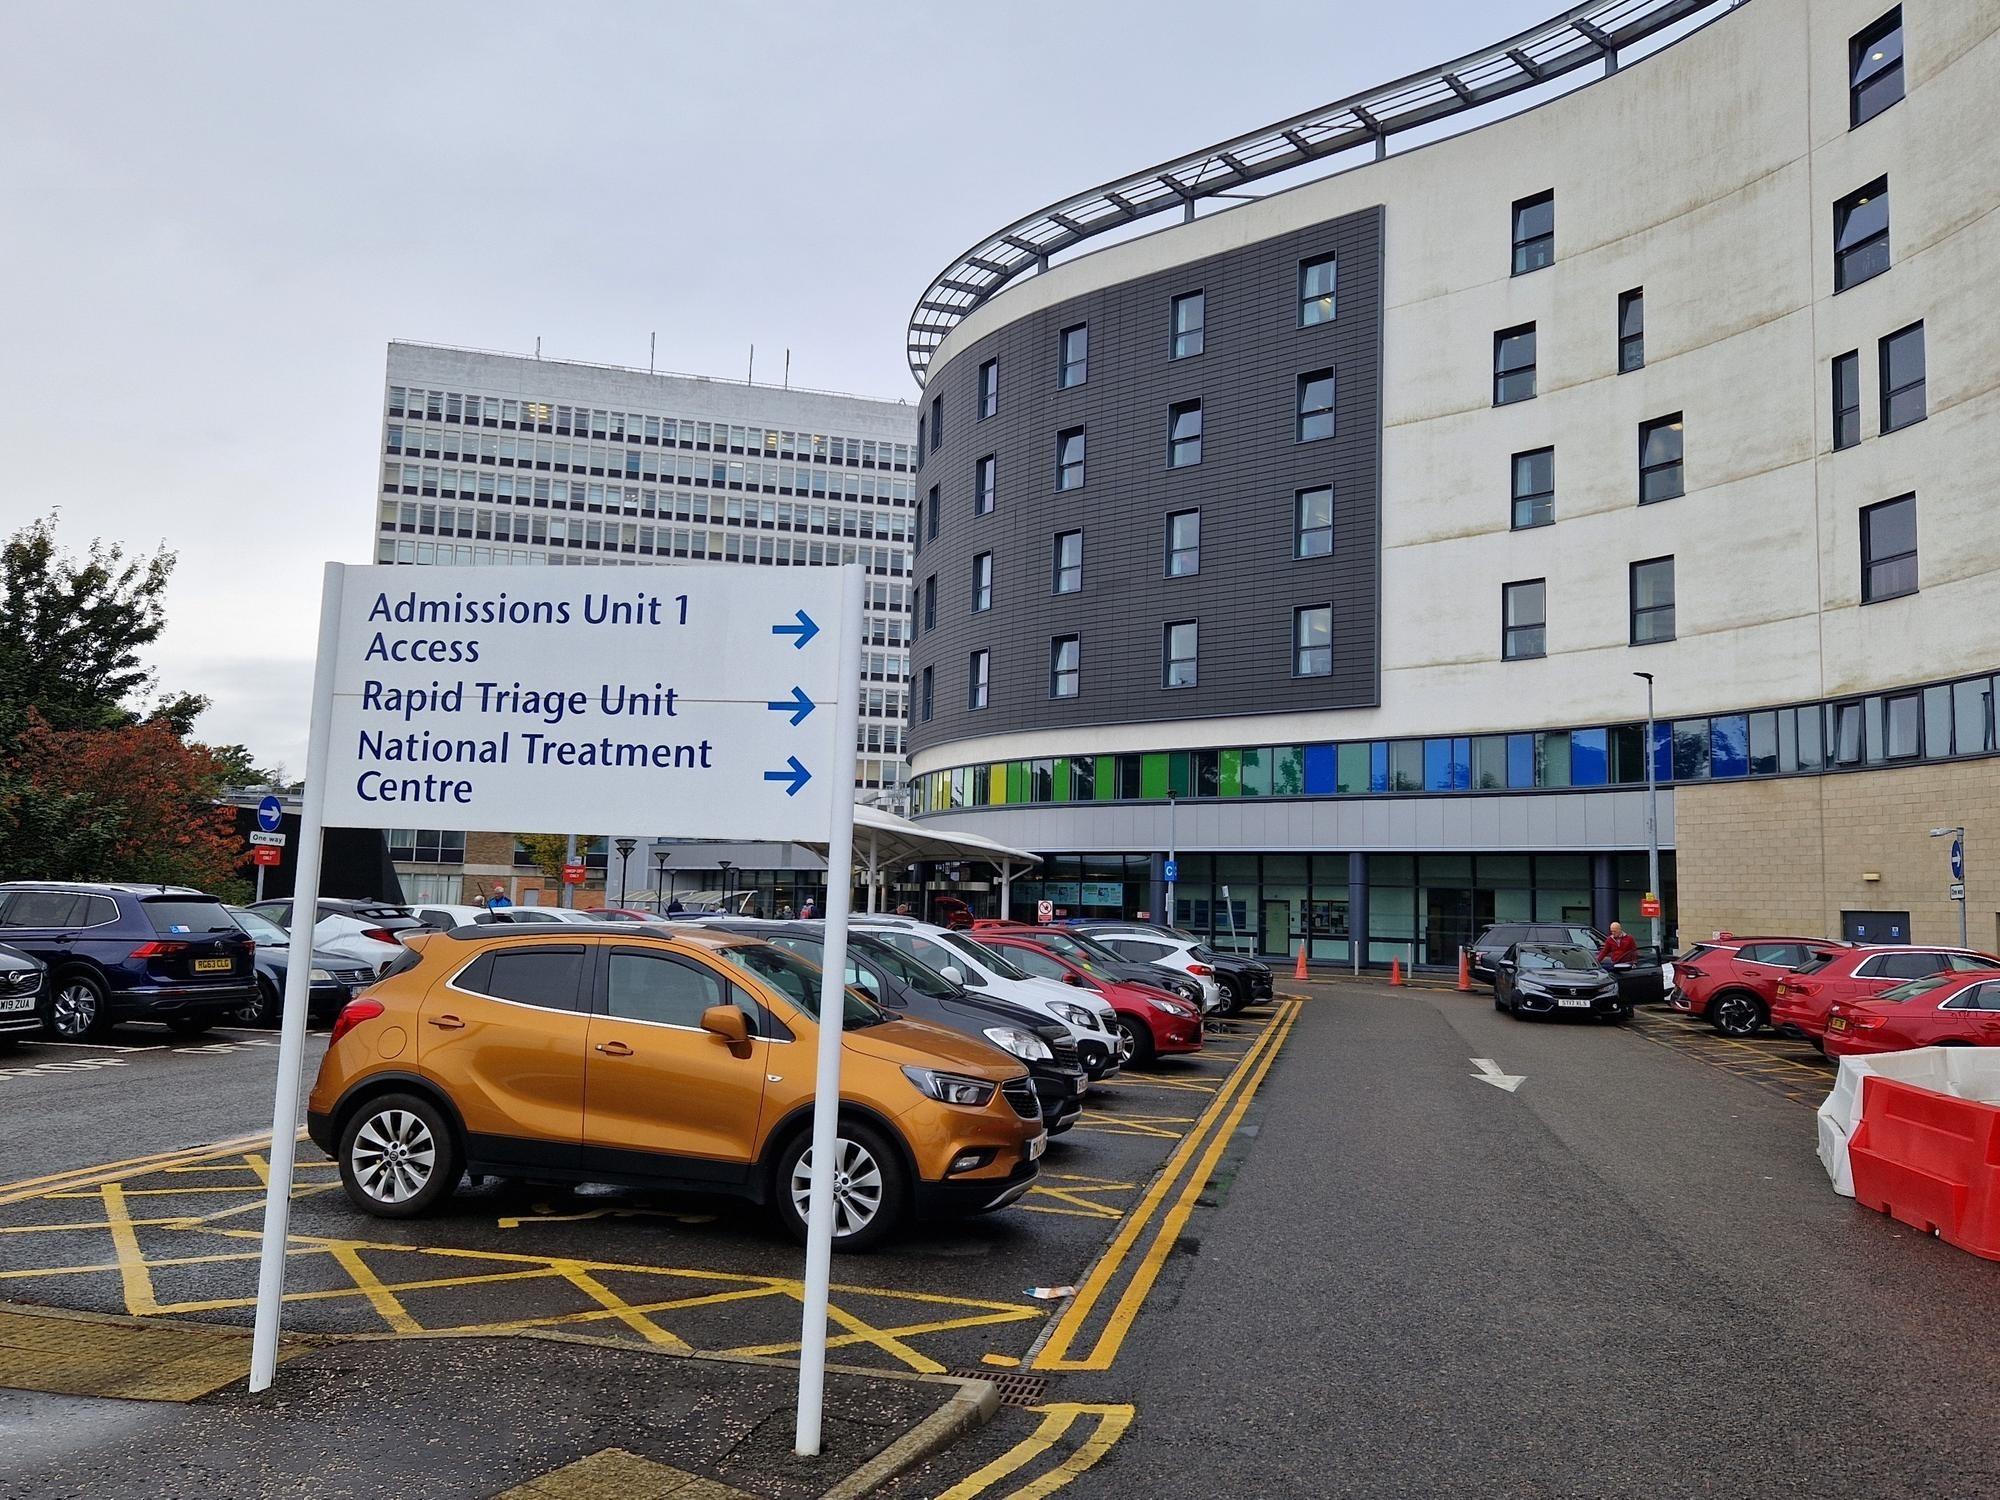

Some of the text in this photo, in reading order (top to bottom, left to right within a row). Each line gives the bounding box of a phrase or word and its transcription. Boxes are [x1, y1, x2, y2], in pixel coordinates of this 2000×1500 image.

[368, 592, 689, 625] Admissions Unit 1
[364, 632, 480, 662] Access
[362, 680, 679, 724] Rapid Triage Unit
[357, 730, 713, 768] National Treatment
[356, 770, 473, 803] Centre
[1166, 865, 1173, 876] C
[15, 999, 30, 1009] ZUA
